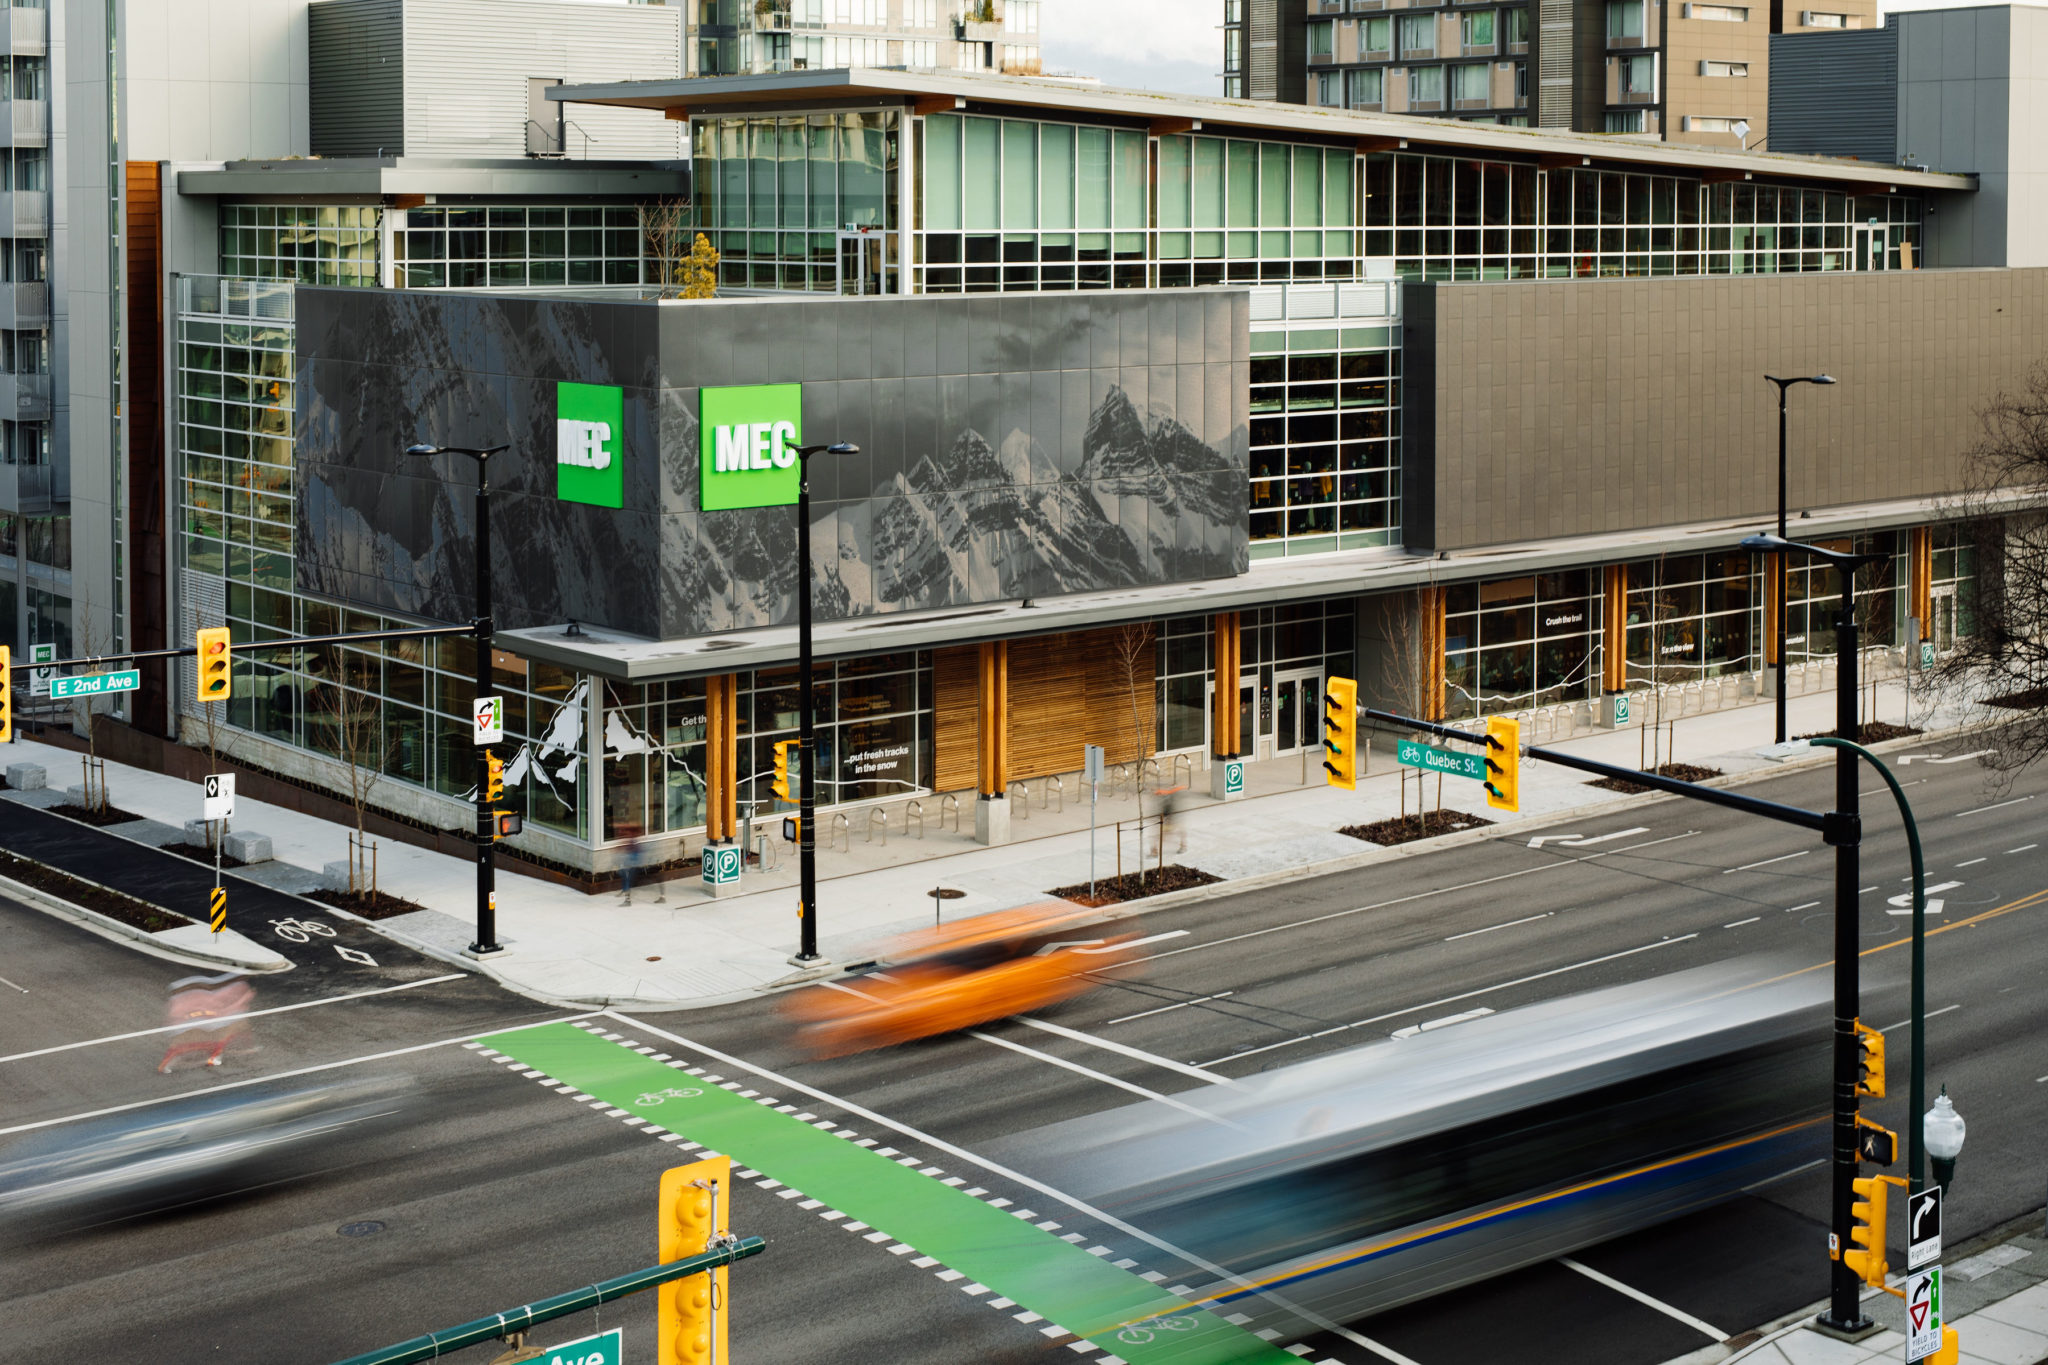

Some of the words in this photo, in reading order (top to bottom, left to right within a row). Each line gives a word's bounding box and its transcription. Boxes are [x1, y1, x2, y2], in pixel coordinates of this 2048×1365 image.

[557, 418, 611, 470] MEC
[715, 420, 796, 472] MEC
[1562, 615, 1571, 624] the
[57, 681, 67, 695] E
[73, 678, 100, 693] 2nd
[106, 676, 132, 689] Ave
[681, 716, 697, 726] Get
[864, 749, 884, 760] fresh
[885, 746, 909, 757] tracks
[855, 765, 863, 774] in
[863, 763, 876, 772] the
[877, 761, 898, 770] snow
[1425, 750, 1462, 770] Quebec
[1464, 758, 1479, 774] St.
[1231, 768, 1238, 781] P
[724, 855, 733, 869] P
